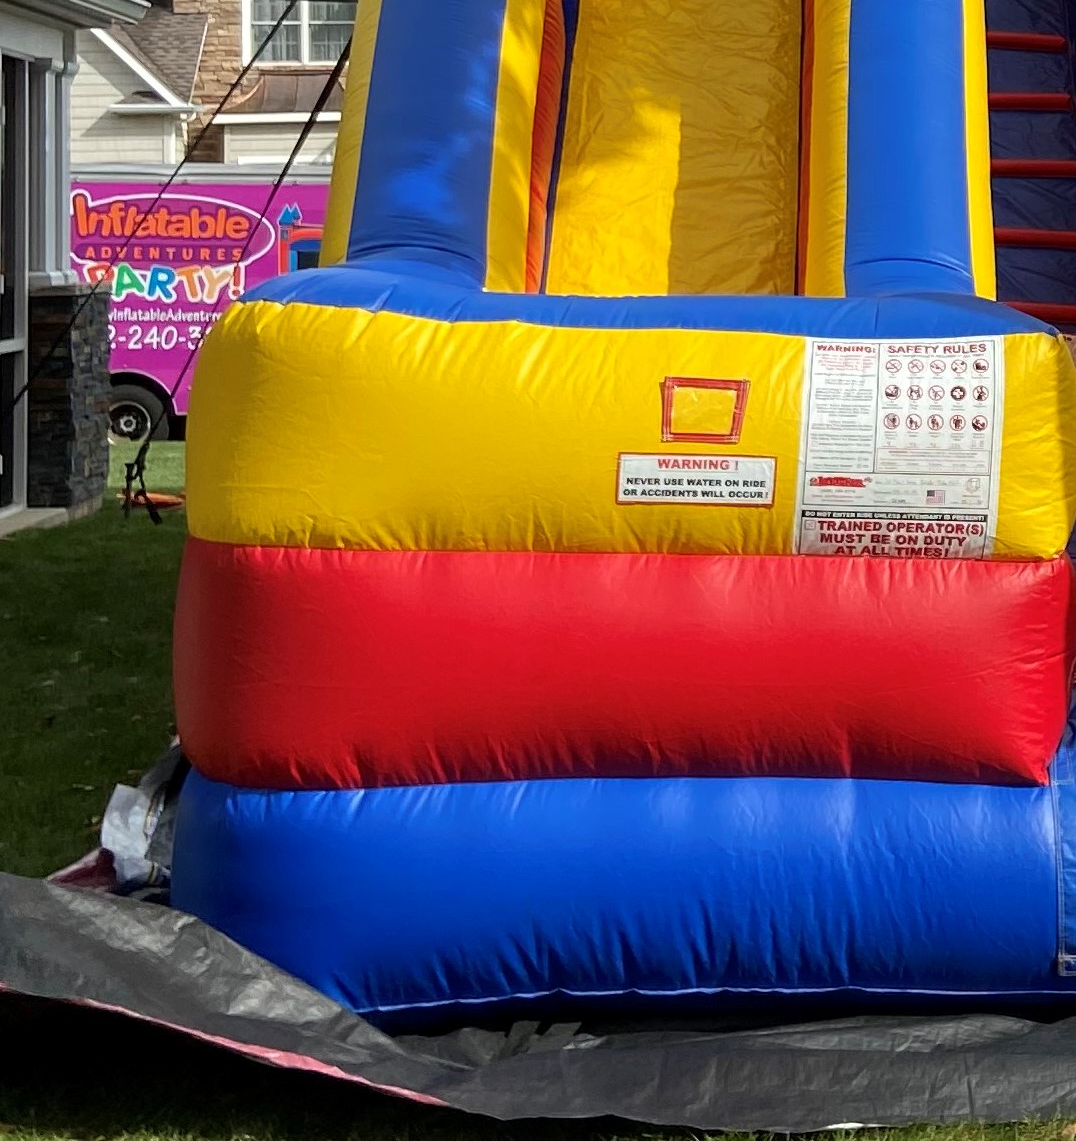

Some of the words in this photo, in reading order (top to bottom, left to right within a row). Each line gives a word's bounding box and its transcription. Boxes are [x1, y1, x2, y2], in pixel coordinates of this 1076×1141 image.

[73, 193, 250, 239] Inflatable
[86, 247, 243, 261] ADVENTURES
[86, 262, 245, 303] PARTY!
[816, 345, 876, 353] WARNING:
[887, 345, 940, 354] SAFETY
[943, 343, 987, 354] RULES
[657, 459, 730, 471] WARNING
[626, 477, 661, 486] NEVER
[663, 477, 684, 486] USE
[686, 478, 722, 487] WATER
[724, 480, 740, 488] ON
[742, 480, 766, 488] RIDE
[623, 489, 638, 497] OR
[640, 489, 699, 498] ACCIDENTS
[701, 490, 725, 498] WILL
[818, 520, 882, 531] TRAINED
[886, 522, 984, 537] OPERATOR(S)
[820, 533, 866, 543] MUST
[870, 534, 891, 544] BE
[895, 534, 919, 545] ON
[923, 535, 967, 547] DUTY
[834, 545, 856, 556] AT
[861, 545, 890, 556] ALL
[894, 547, 949, 558] TIMES!
